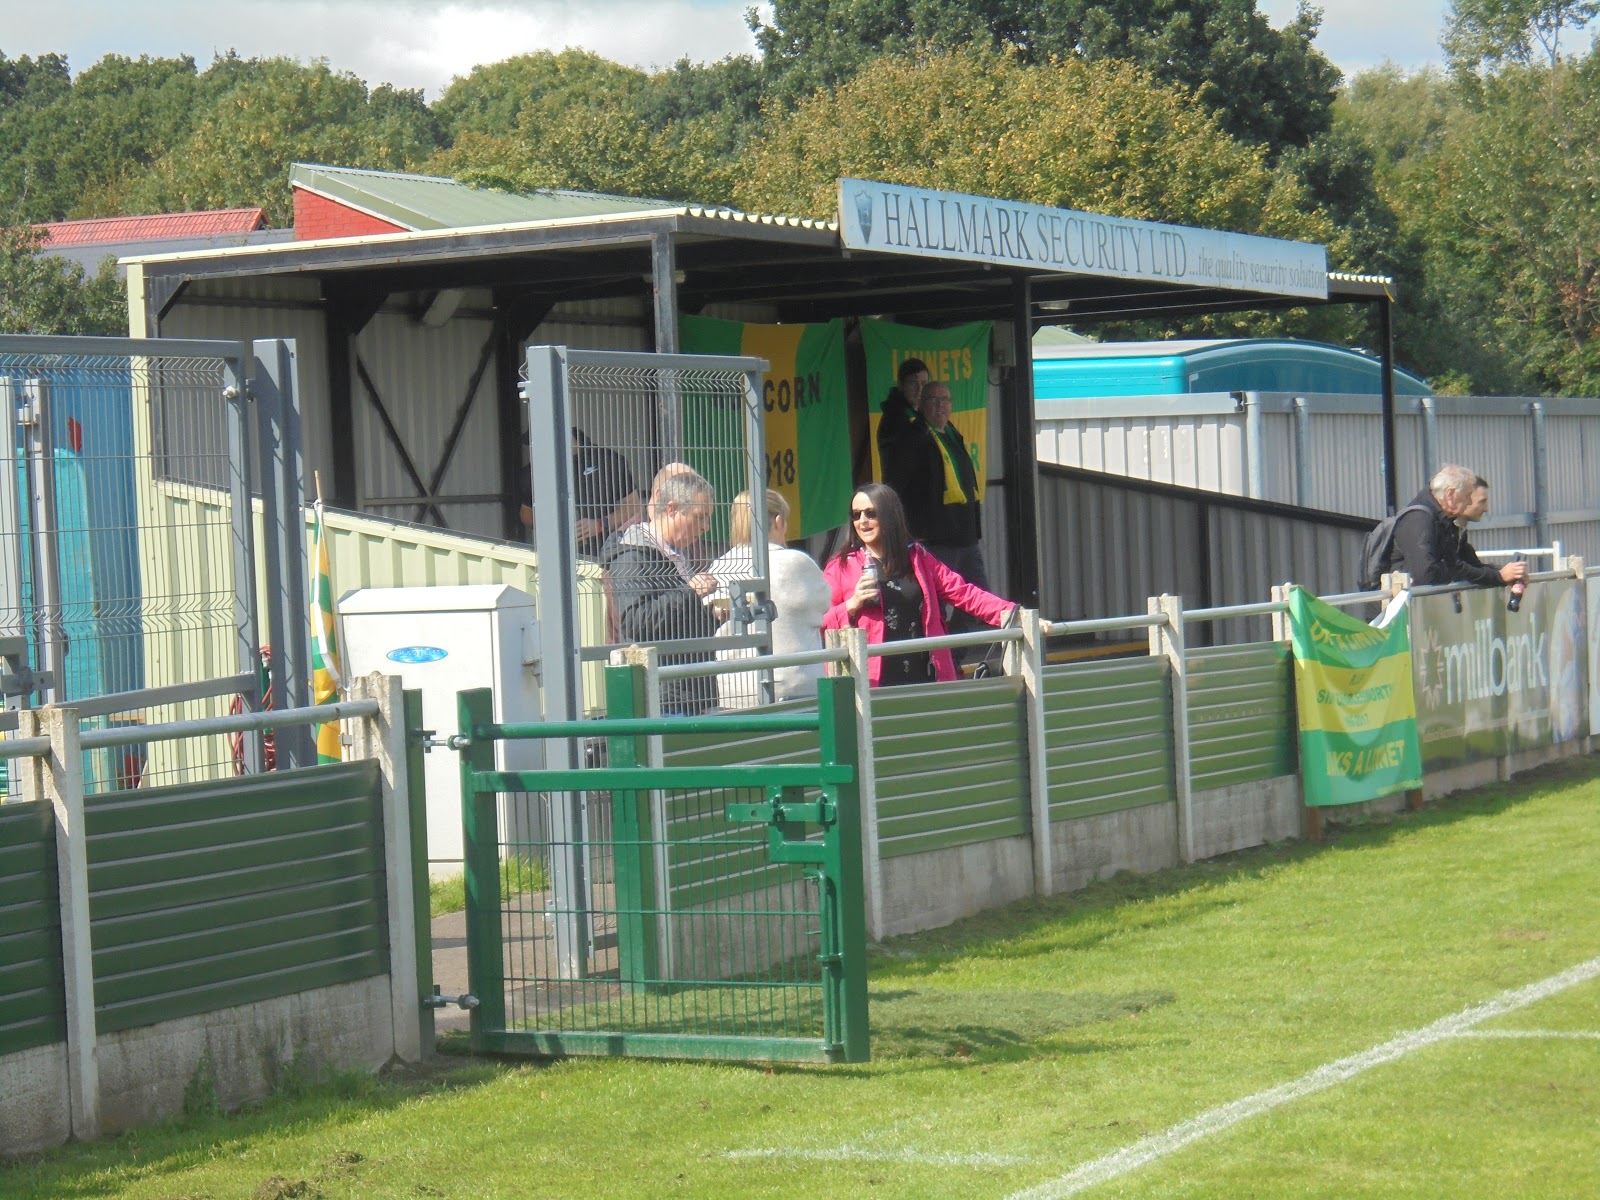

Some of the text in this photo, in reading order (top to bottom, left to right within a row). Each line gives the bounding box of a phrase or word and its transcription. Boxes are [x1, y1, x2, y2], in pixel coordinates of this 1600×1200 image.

[882, 192, 1033, 260] HALLMARK
[1036, 212, 1142, 273] SECURITY
[1148, 229, 1187, 277] LTD
[1215, 251, 1248, 288] quality
[1250, 258, 1287, 291] security
[1289, 259, 1325, 290] solution
[892, 347, 973, 382] LNETS
[1444, 613, 1547, 705] millbank
